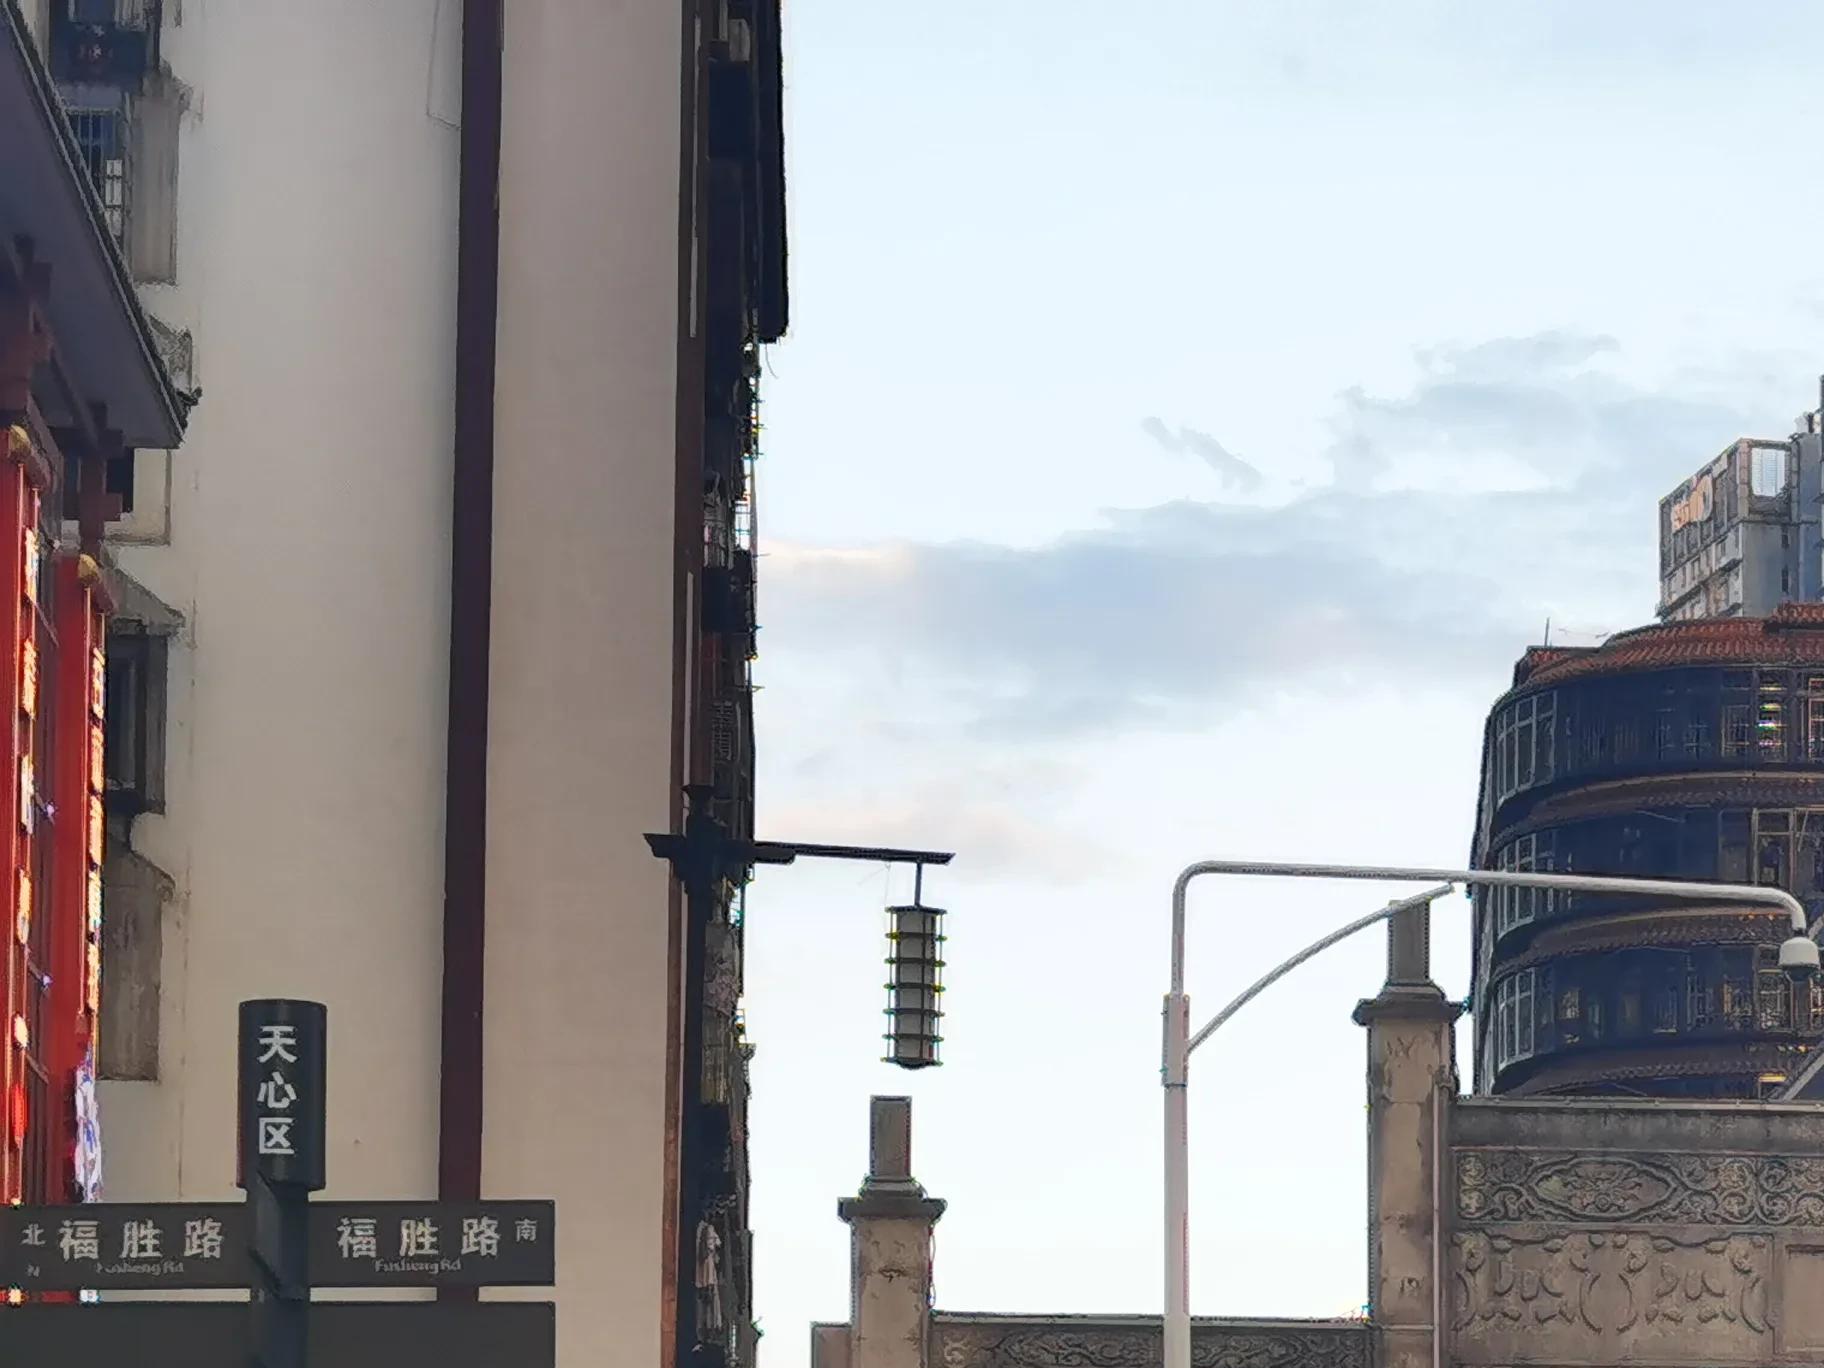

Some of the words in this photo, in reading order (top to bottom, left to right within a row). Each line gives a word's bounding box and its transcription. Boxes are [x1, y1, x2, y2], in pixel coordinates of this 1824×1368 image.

[258, 1025, 298, 1155] 天心区
[22, 1223, 46, 1246] 北
[59, 1218, 223, 1261] 福胜路
[338, 1216, 501, 1259] 福胜路
[515, 1218, 537, 1242] 南
